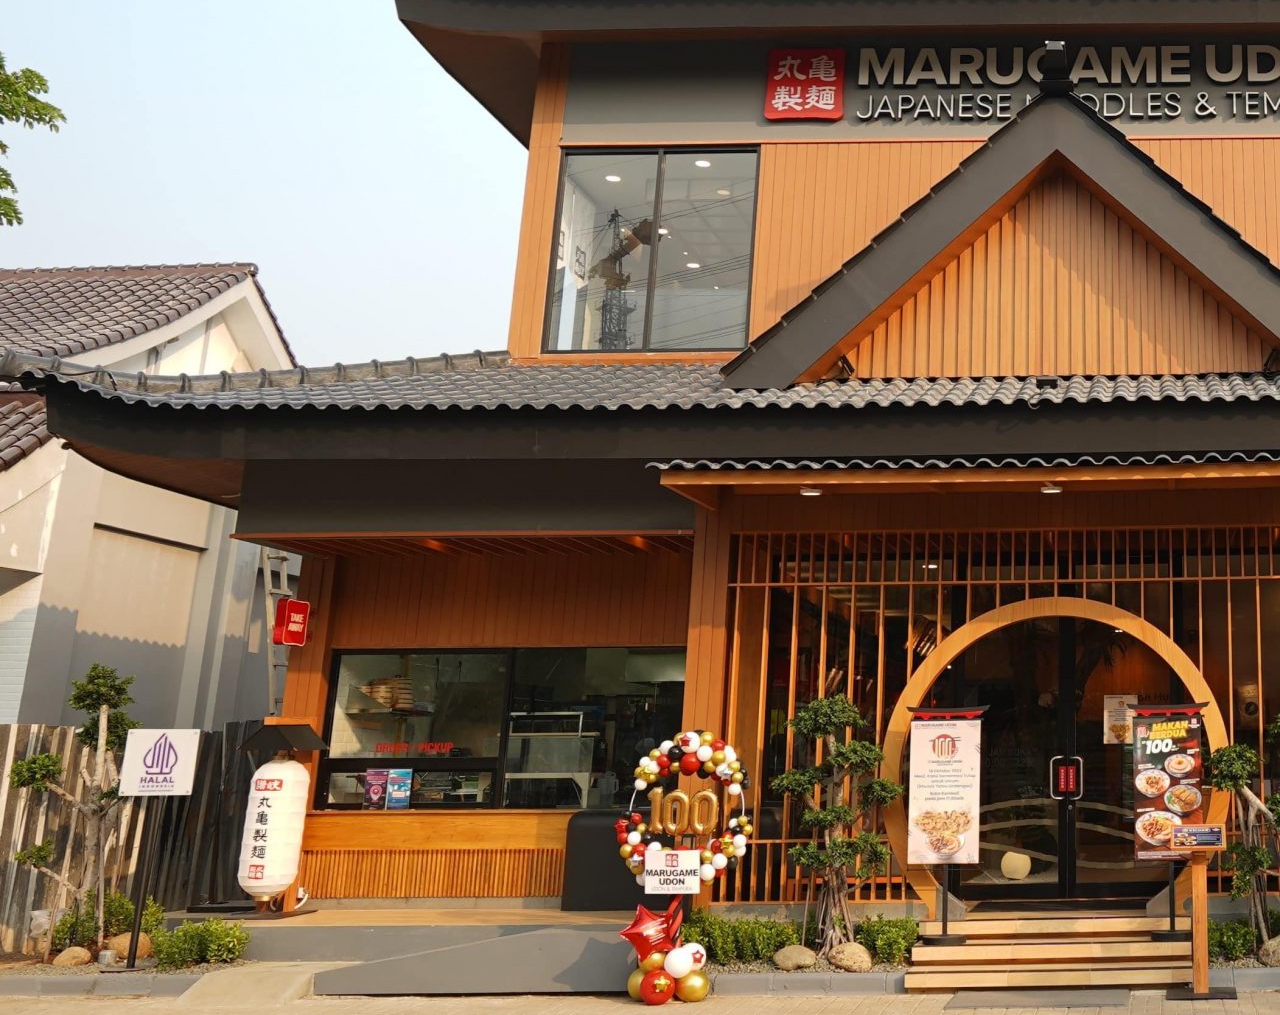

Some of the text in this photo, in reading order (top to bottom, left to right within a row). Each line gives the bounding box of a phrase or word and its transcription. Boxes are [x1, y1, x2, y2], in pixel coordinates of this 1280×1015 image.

[773, 55, 837, 82] 丸亀
[856, 93, 1012, 119] JAPANESE
[1194, 91, 1217, 117] &
[290, 612, 305, 623] TAKE
[287, 622, 304, 633] AWAY
[1152, 720, 1189, 732] MAKAN
[1149, 729, 1188, 740] BERDUA
[417, 740, 455, 754] PICKUP
[1145, 738, 1173, 755] 100
[139, 776, 175, 784] HALAL
[647, 786, 720, 835] 100
[645, 868, 699, 877] MARUGAME
[659, 878, 685, 886] UDON
